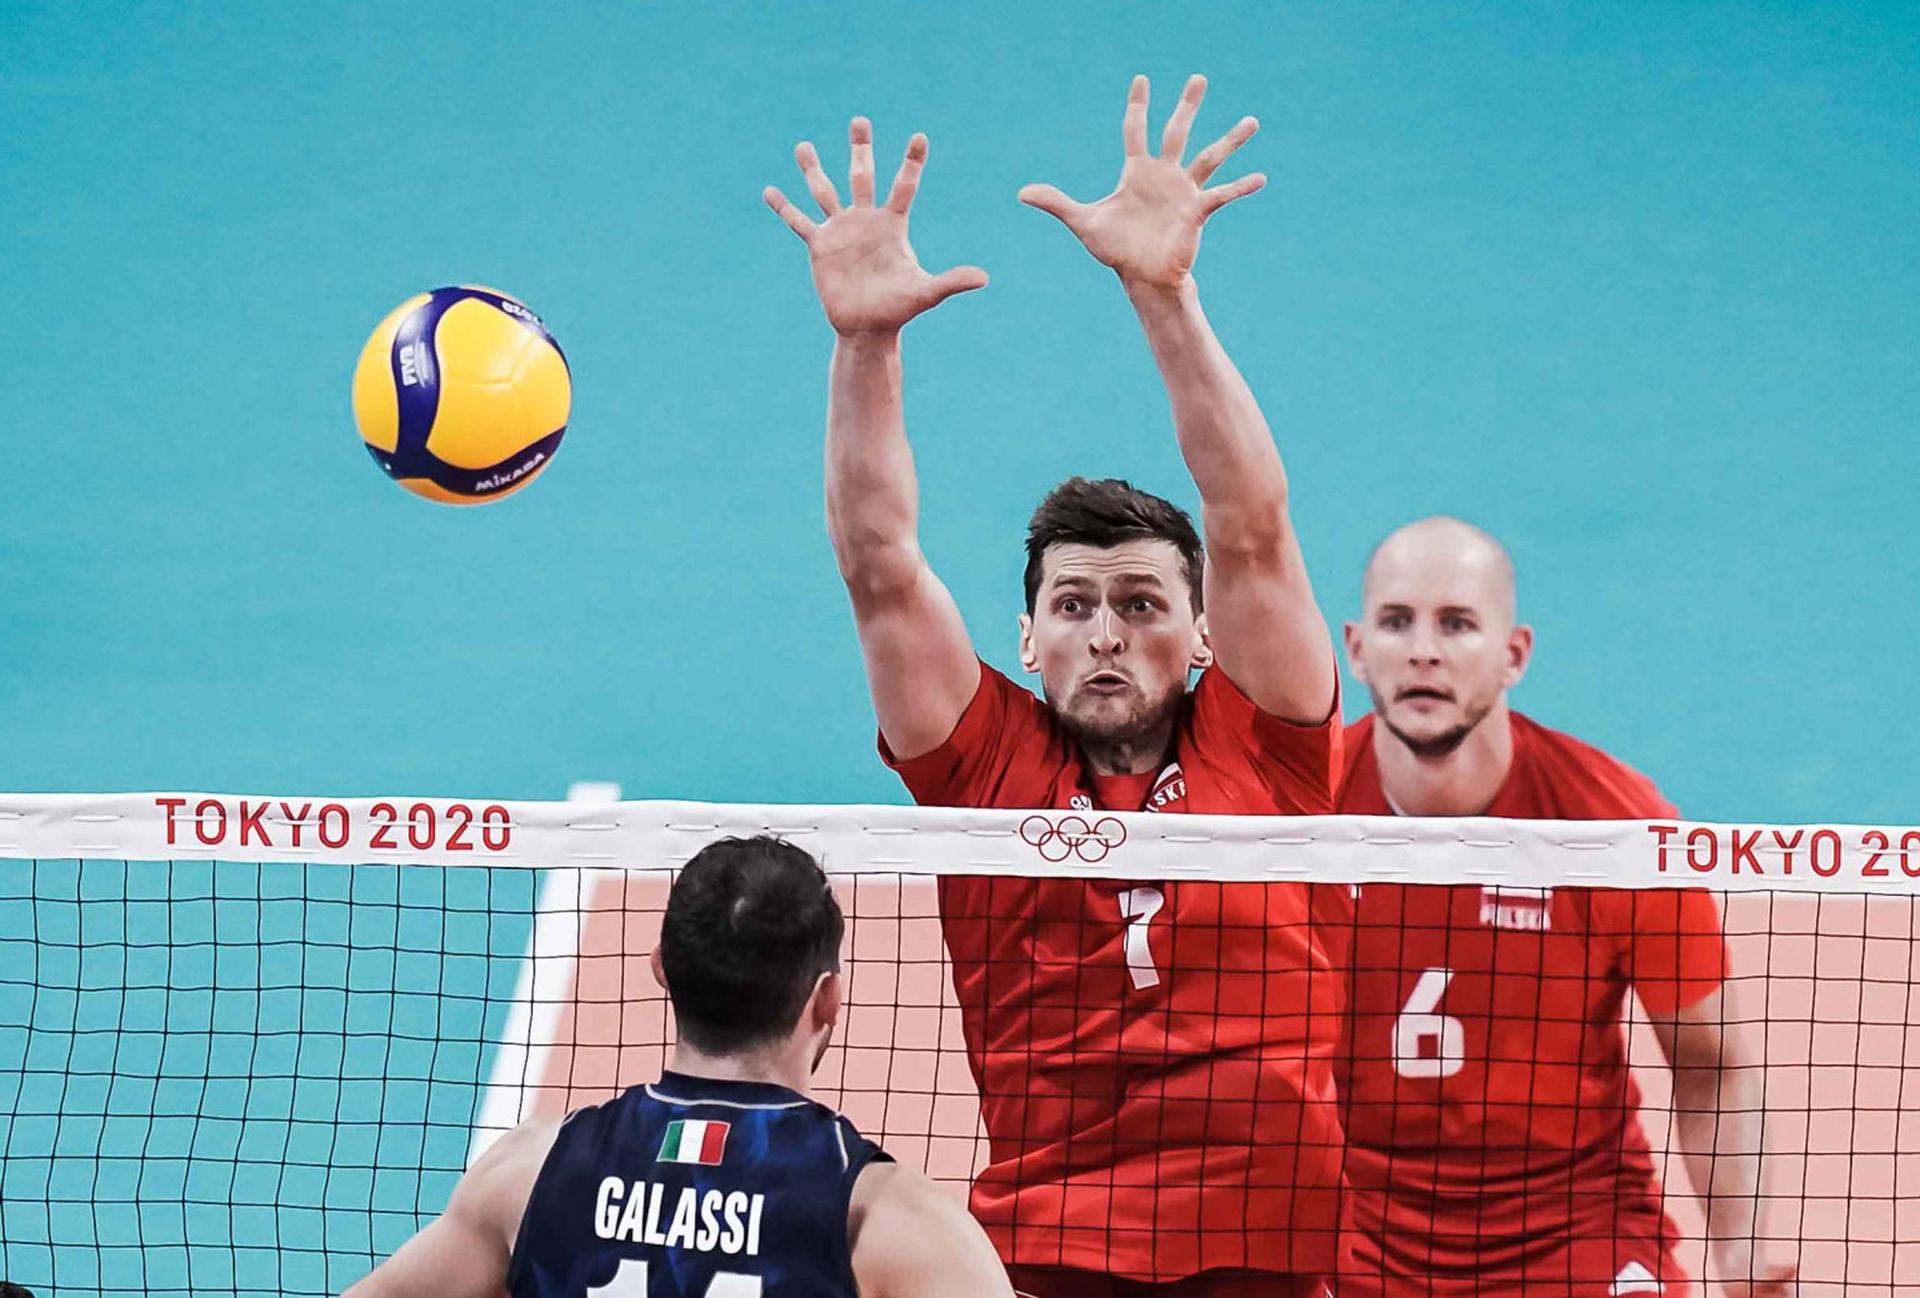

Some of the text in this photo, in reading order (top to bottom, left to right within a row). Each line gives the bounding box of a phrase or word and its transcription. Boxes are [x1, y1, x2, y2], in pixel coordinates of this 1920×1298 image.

[156, 798, 511, 852] TOKYO 2020
[1648, 826, 1842, 877] TOKYO
[1118, 887, 1164, 990] 7
[1392, 966, 1465, 1079] 6
[594, 1176, 765, 1256] GALASSI
